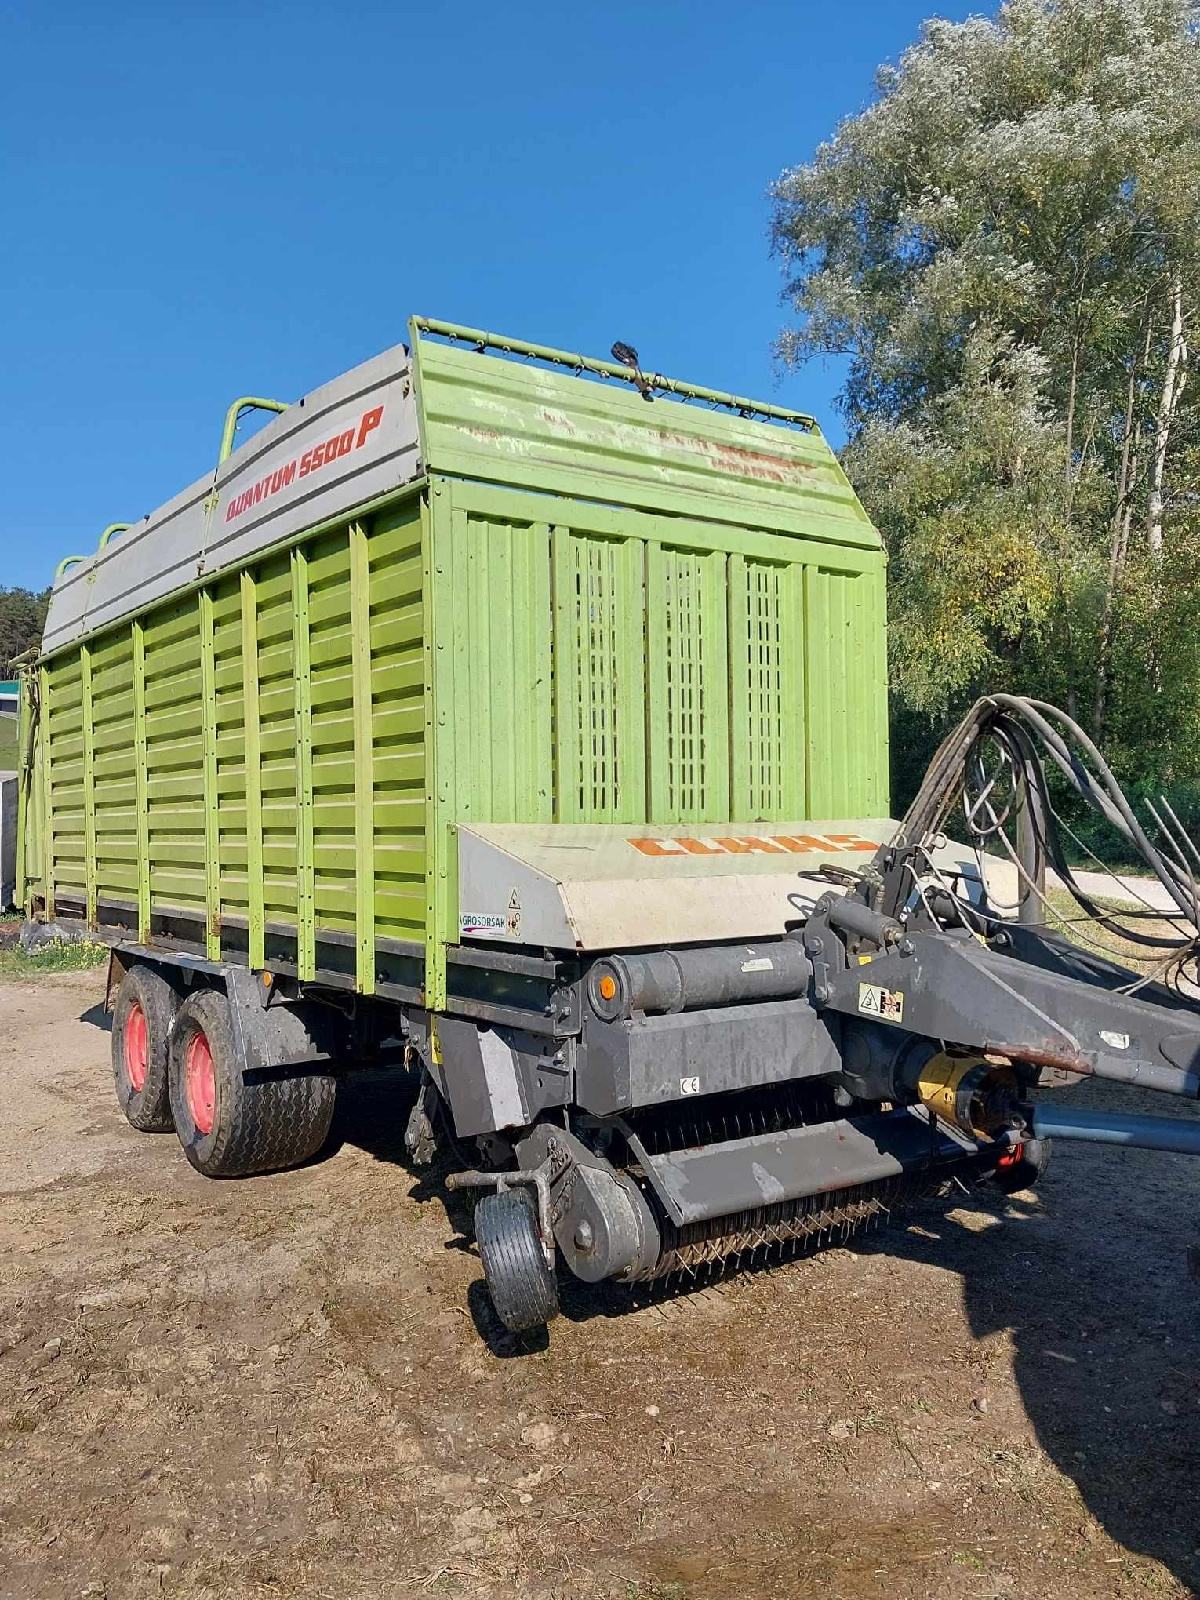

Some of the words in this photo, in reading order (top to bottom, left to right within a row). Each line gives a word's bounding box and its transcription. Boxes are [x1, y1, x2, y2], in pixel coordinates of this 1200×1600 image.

[225, 462, 297, 523] QUANTUM
[299, 428, 356, 479] 5500
[356, 405, 384, 449] P
[625, 834, 881, 856] CLAAS
